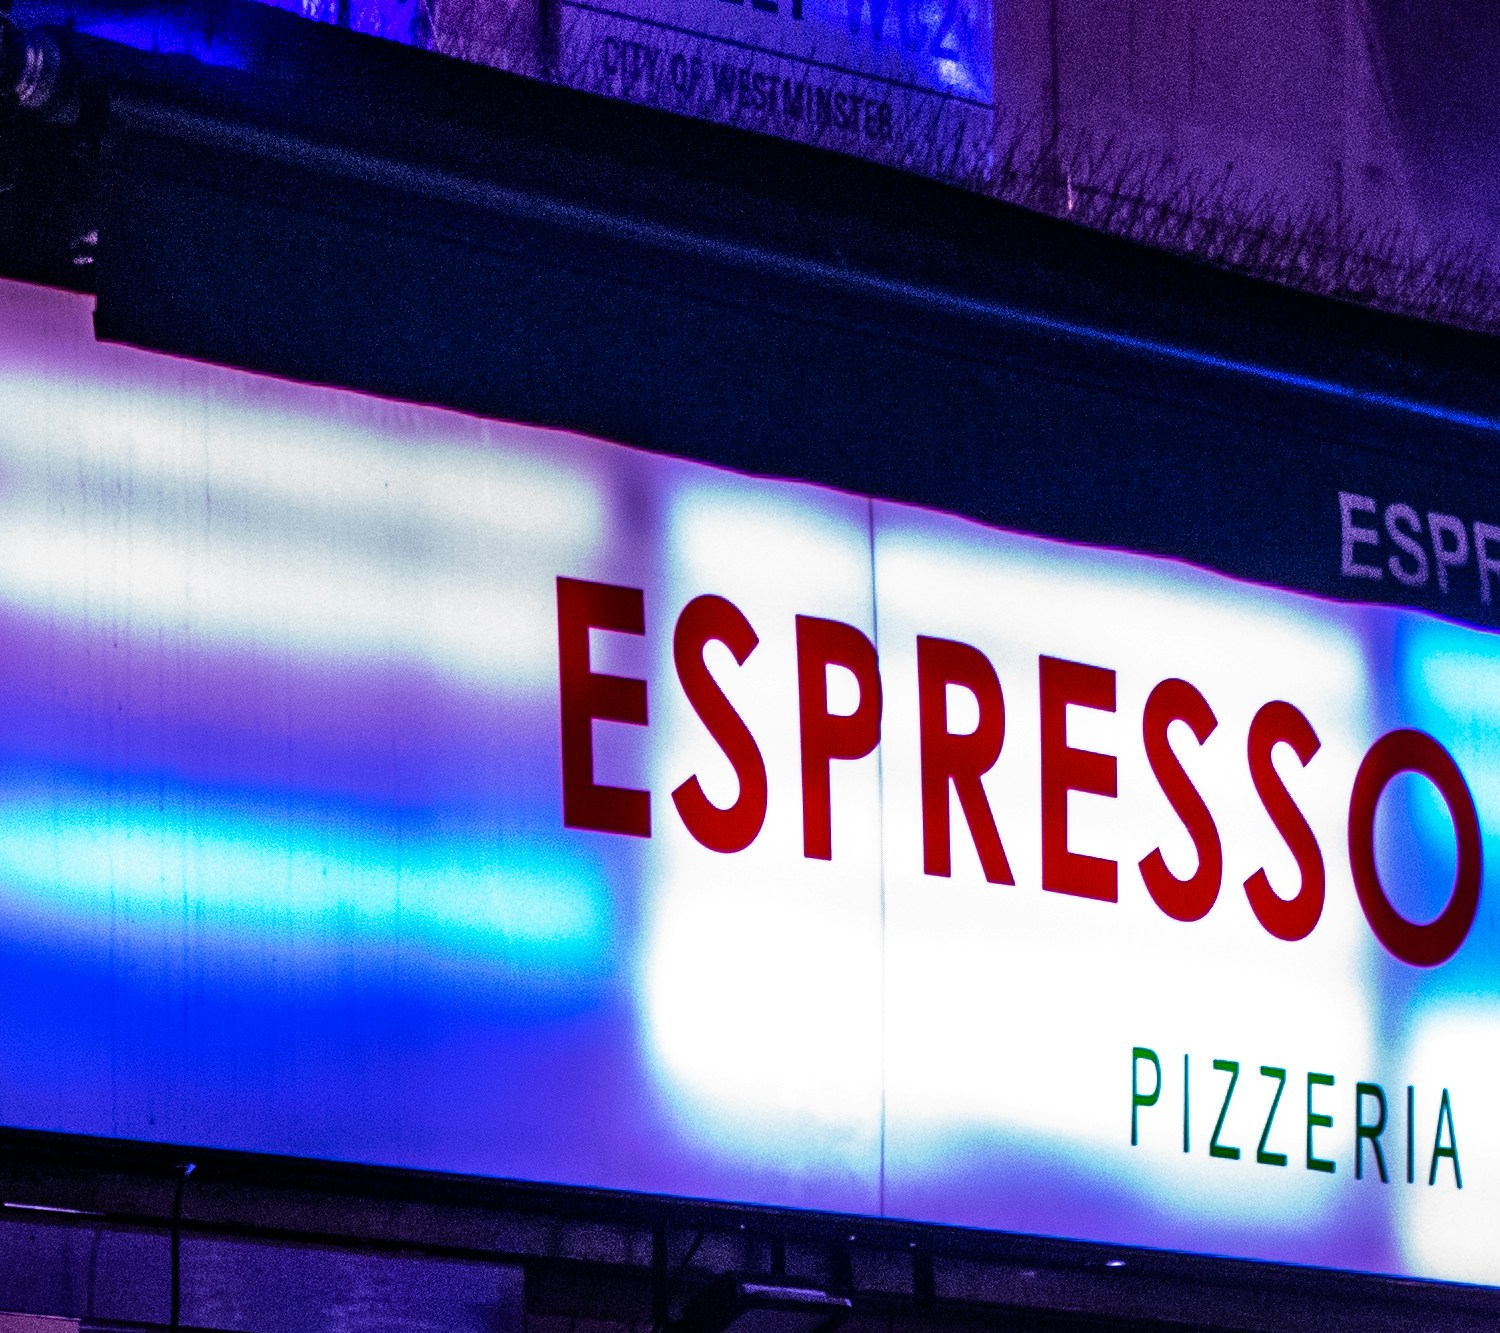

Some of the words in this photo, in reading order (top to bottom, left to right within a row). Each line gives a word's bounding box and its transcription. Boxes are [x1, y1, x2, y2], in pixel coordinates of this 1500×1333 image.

[603, 36, 661, 80] CITY
[671, 53, 704, 93] OF
[713, 61, 895, 141] WESTMINSTER
[556, 575, 1484, 970] ESPRESSO
[1130, 1045, 1465, 1190] PIZZERIA
